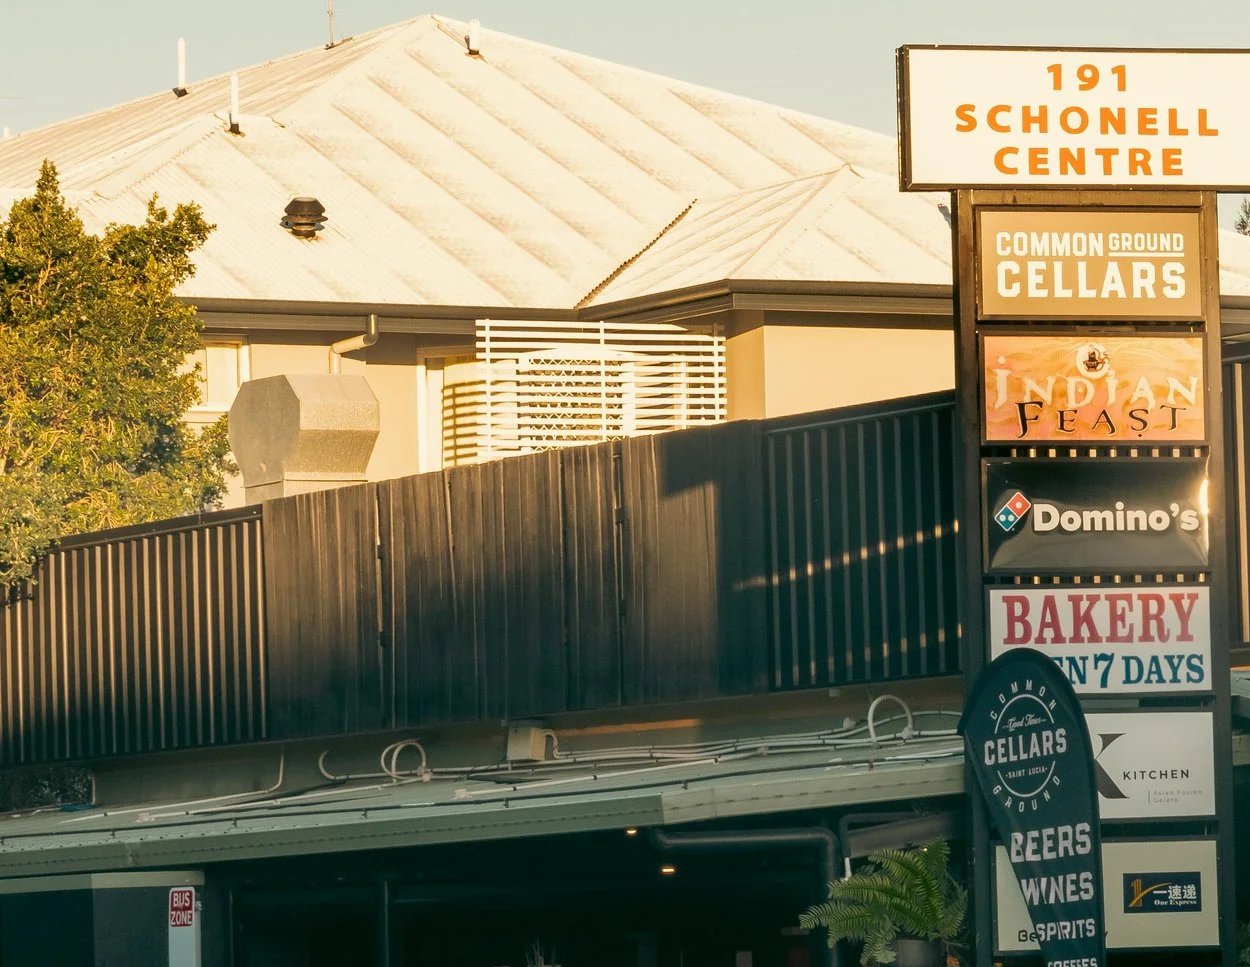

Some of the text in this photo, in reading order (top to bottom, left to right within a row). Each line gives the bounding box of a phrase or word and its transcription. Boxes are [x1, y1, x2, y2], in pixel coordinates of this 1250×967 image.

[1047, 63, 1127, 92] 191
[955, 103, 1219, 137] SCHONELL
[993, 146, 1184, 176] CENTRE
[996, 231, 1184, 257] COMMON GROUND
[996, 260, 1186, 299] CELLARS
[1015, 400, 1187, 438] FEAST
[1033, 501, 1200, 532] Domino's
[1001, 592, 1199, 645] BAKERY
[1093, 652, 1115, 689] 7
[1122, 654, 1205, 685] DAYS
[990, 679, 1057, 720] COMMON
[984, 727, 1068, 766] CELLARS
[1007, 764, 1046, 779] SAINT LUCIA
[1122, 768, 1190, 781] KITCHEN
[992, 775, 1061, 813] GROUND
[1010, 822, 1092, 863] BEERS
[173, 892, 190, 907] BUS
[1020, 871, 1094, 906] WINES
[1153, 884, 1197, 900] 一速递
[1169, 899, 1197, 907] Express
[170, 910, 193, 925] ZONE
[1035, 918, 1096, 942] SPIRITS
